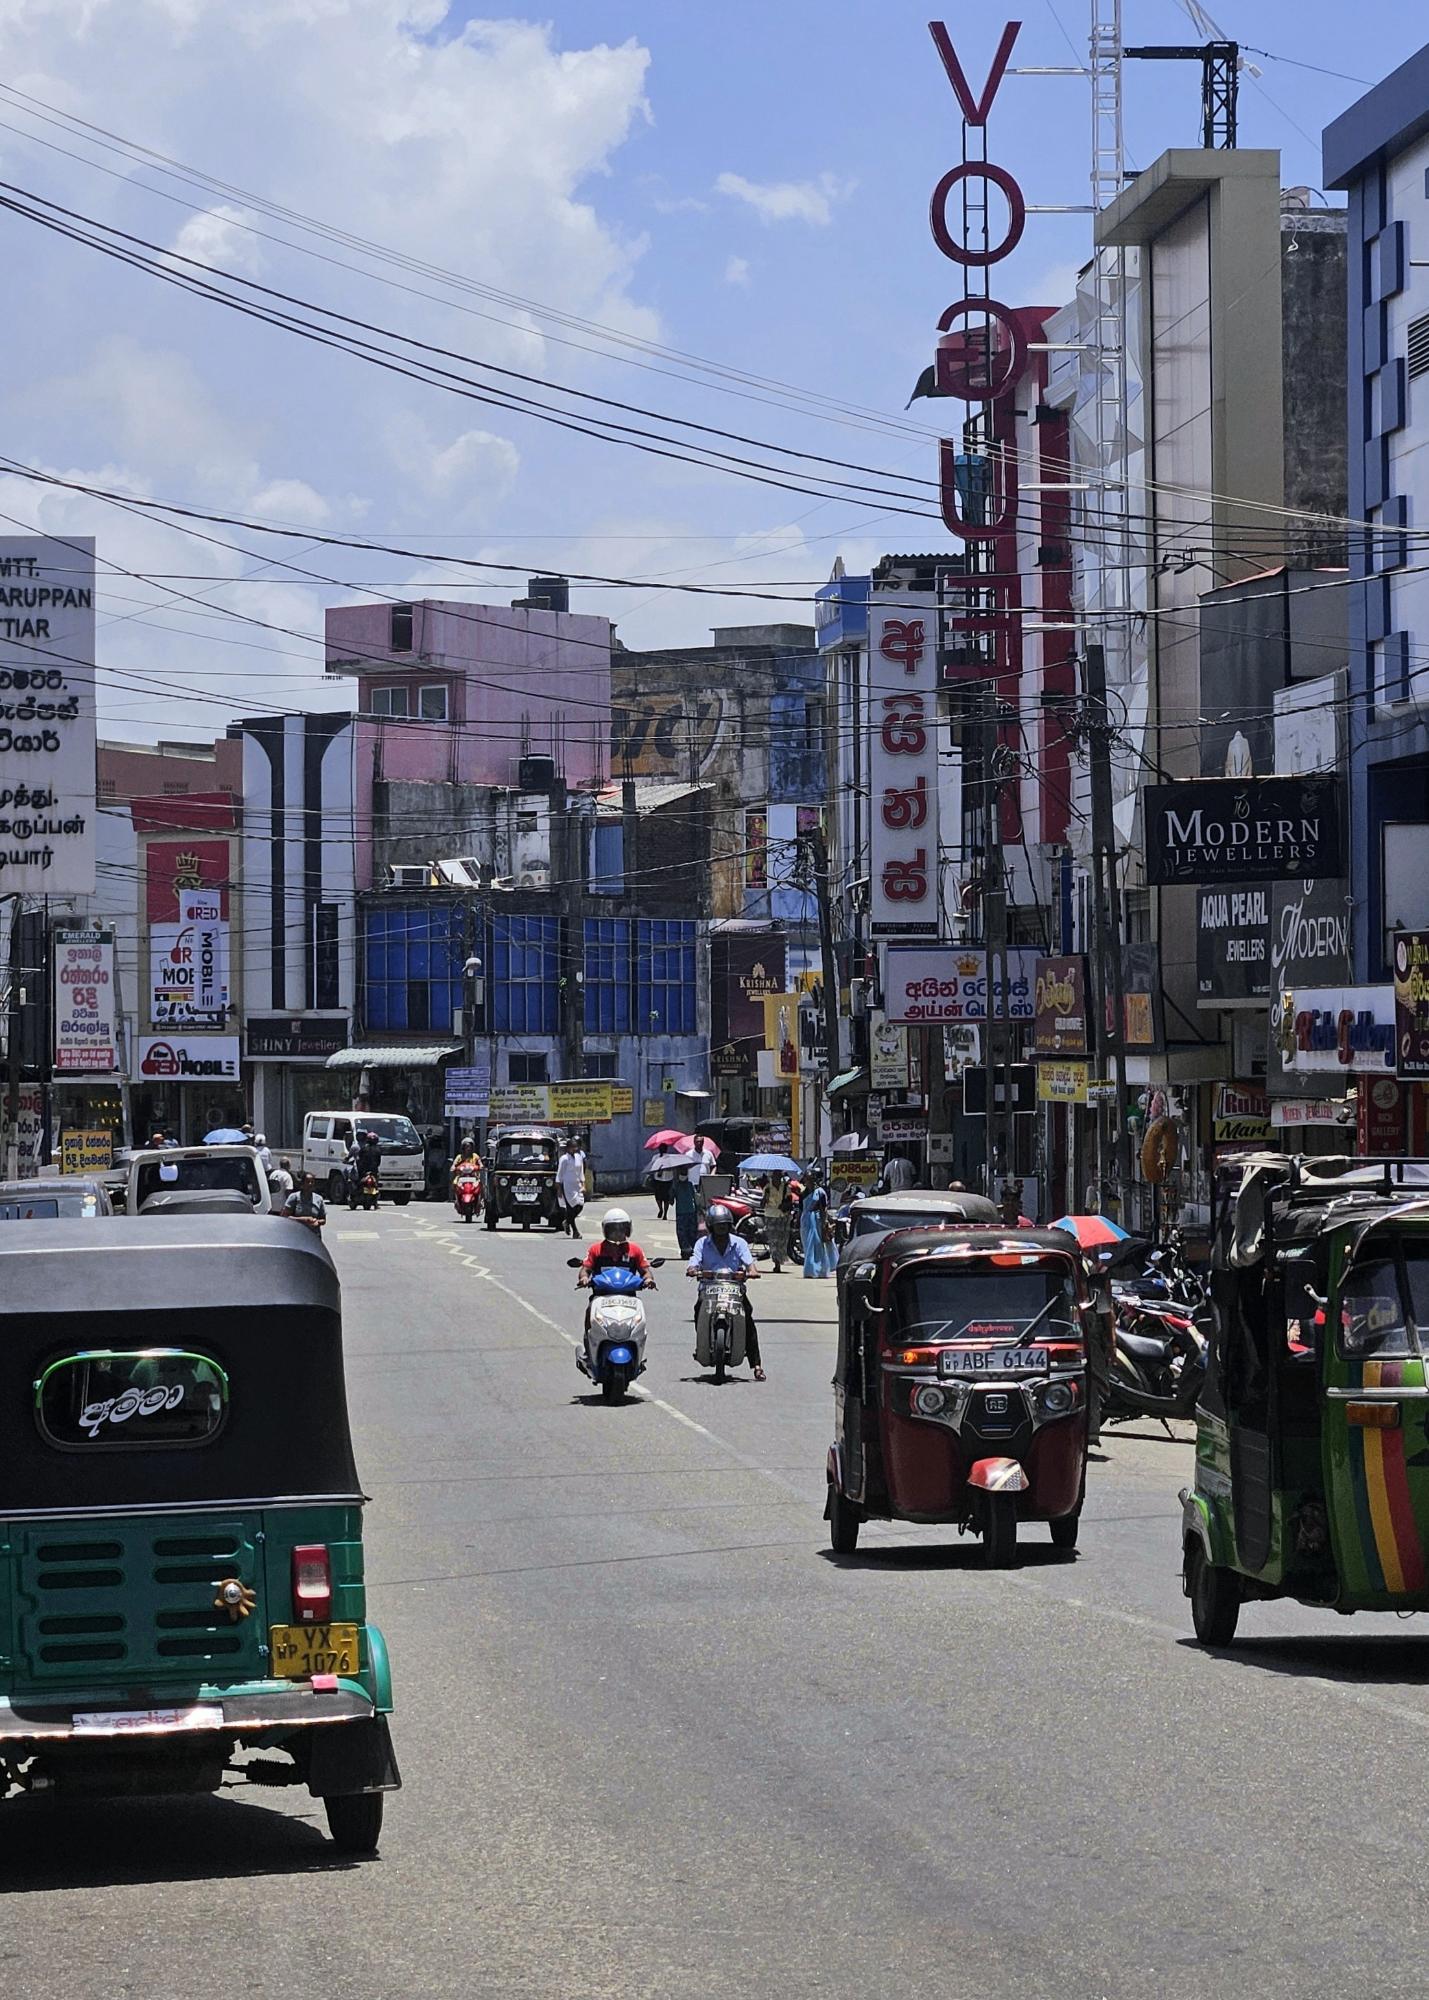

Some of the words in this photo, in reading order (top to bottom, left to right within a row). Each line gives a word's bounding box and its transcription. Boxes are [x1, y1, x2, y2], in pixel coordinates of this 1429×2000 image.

[1164, 809, 1320, 847] MODERN
[1175, 844, 1316, 866] JEWELLERS
[1201, 894, 1229, 928] AQUA
[1231, 891, 1268, 926] PEARL
[1226, 938, 1265, 962] JEWELLERS
[739, 976, 778, 989] KRISHNA
[251, 1038, 292, 1051] SHINY
[1219, 1121, 1270, 1140] Mart
[963, 1352, 996, 1370] ABF
[1004, 1351, 1046, 1368] 6144
[302, 1650, 350, 1674] 1076
